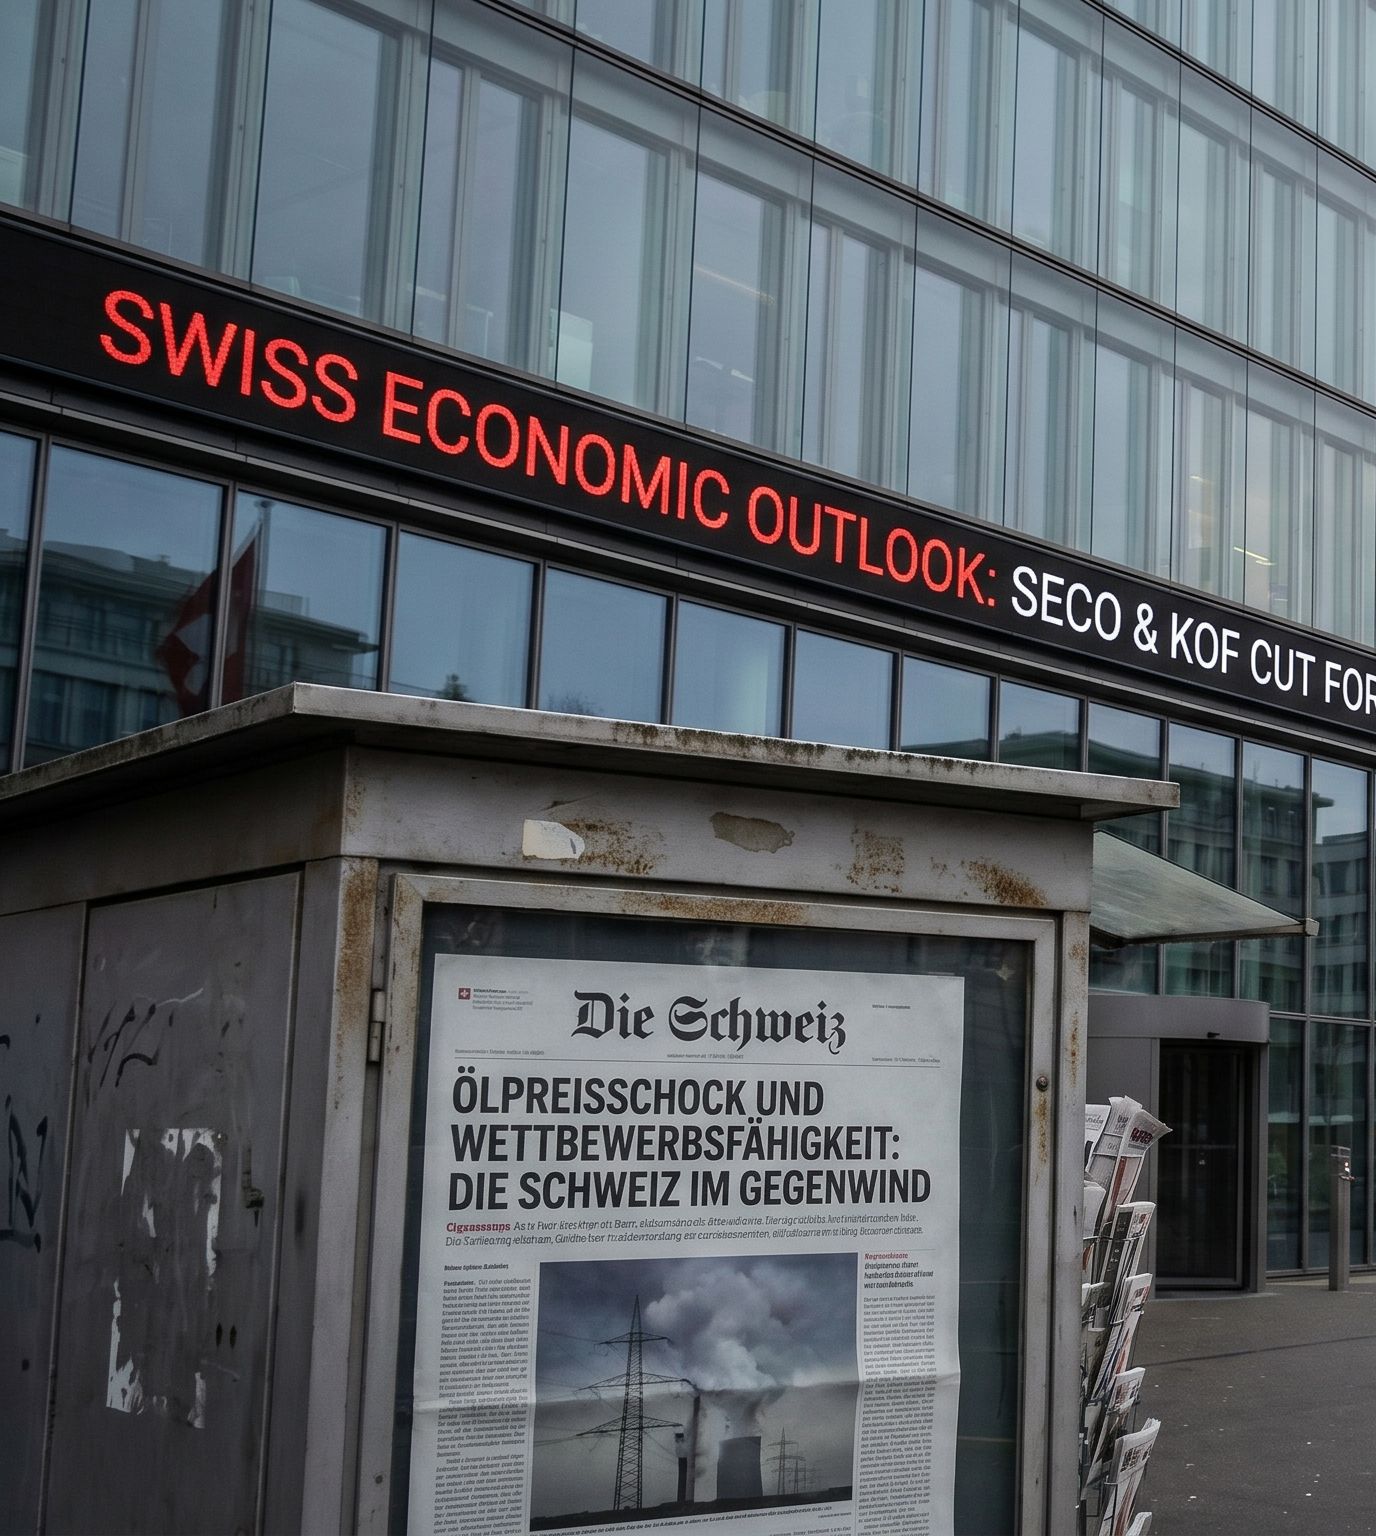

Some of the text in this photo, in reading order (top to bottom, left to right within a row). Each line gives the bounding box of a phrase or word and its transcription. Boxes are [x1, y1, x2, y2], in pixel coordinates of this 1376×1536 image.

[100, 290, 358, 423] SWISS
[382, 371, 730, 529] ECONOMIC
[747, 486, 996, 606] OUTLOOK:
[1011, 565, 1122, 641] SECO
[1133, 602, 1159, 655] &
[1170, 612, 1240, 674] KOF
[1250, 638, 1316, 697] CUT
[570, 989, 655, 1040] Die
[668, 995, 847, 1055] Schweiz
[452, 1065, 824, 1116] ÖLPREISSCHOCK UND
[450, 1116, 900, 1162] WETTBEWERBSFÄHIGKEIT:
[448, 1169, 931, 1211] DIE SCHWEIZ IM GEGENWIND
